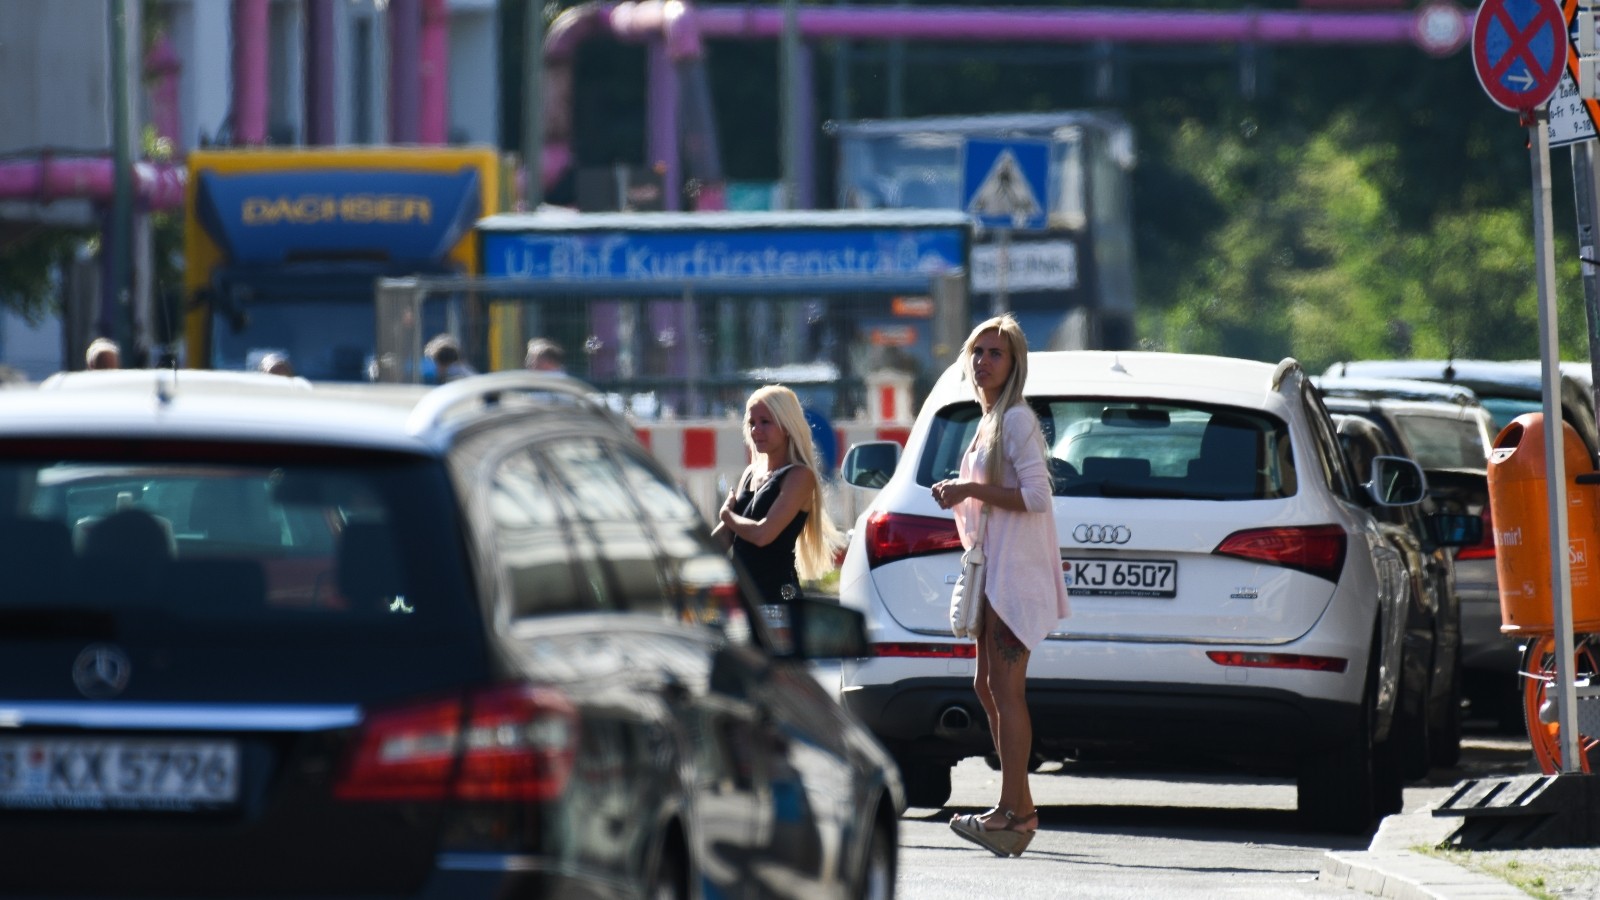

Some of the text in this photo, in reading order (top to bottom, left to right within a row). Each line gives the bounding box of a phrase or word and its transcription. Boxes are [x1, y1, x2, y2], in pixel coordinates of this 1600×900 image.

[1550, 106, 1564, 119] o-Fr
[242, 193, 431, 225] DACHSER
[1074, 563, 1172, 588] KJ 6507
